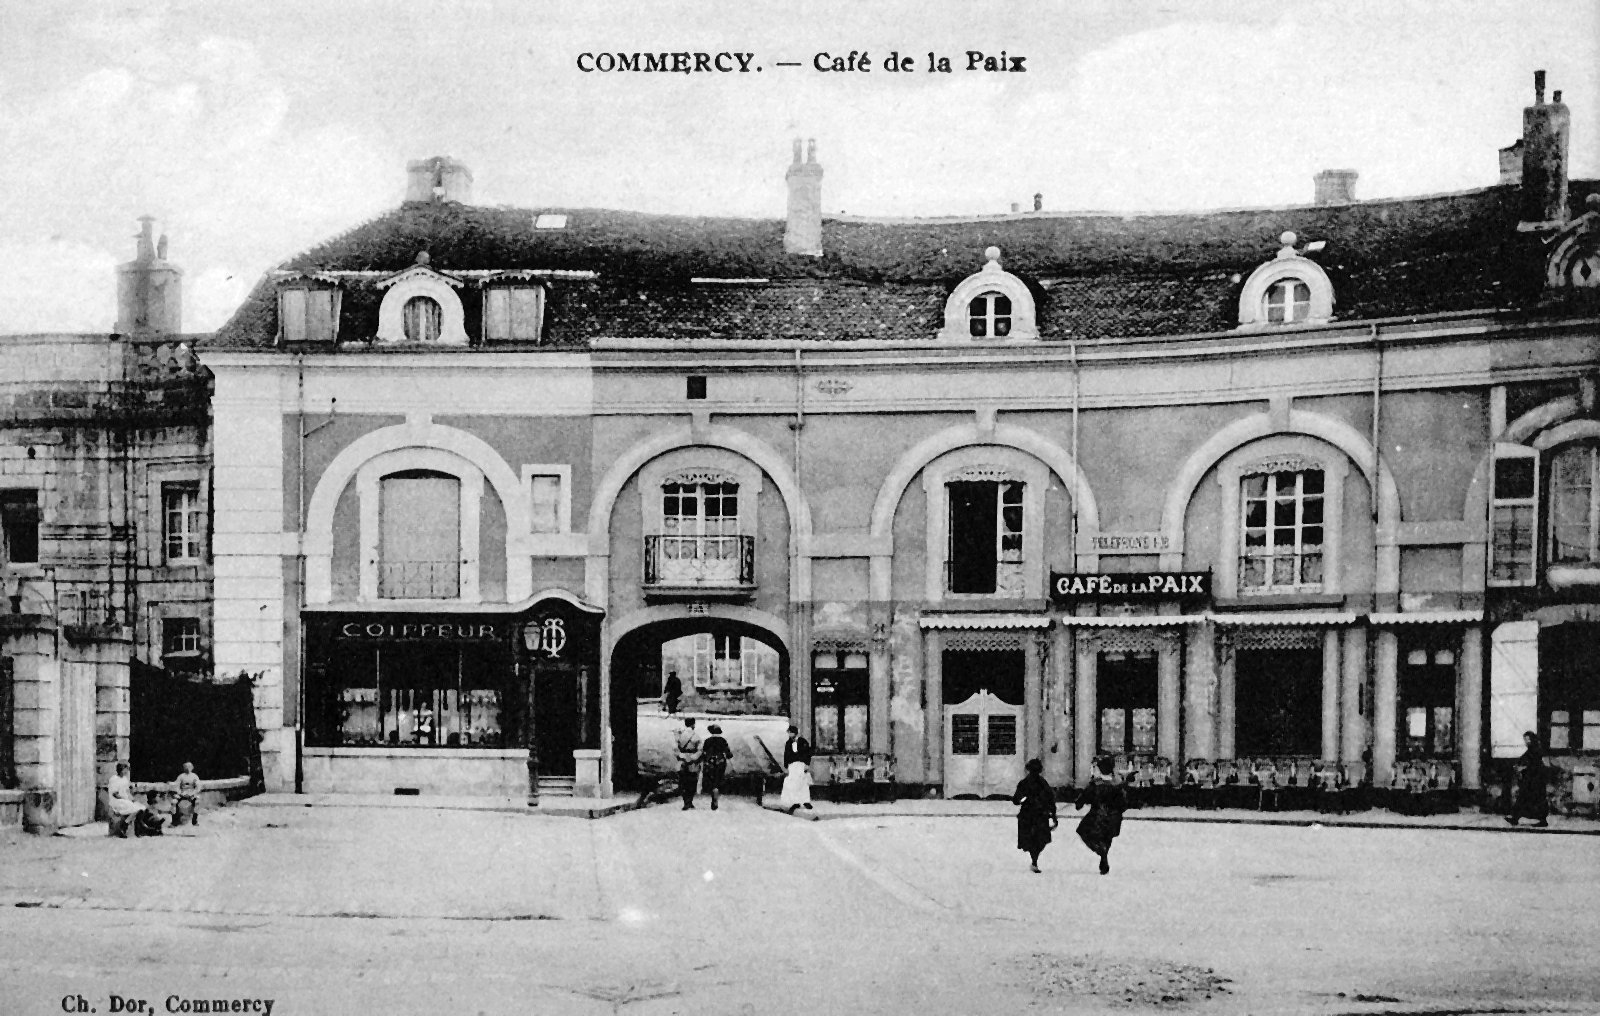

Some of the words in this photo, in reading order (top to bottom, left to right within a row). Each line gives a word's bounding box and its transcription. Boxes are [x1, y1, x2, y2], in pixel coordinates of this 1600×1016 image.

[1113, 583, 1128, 594] DE
[1131, 583, 1149, 593] LA
[1149, 575, 1204, 593] PAIX
[342, 622, 495, 639] COIFFEUR
